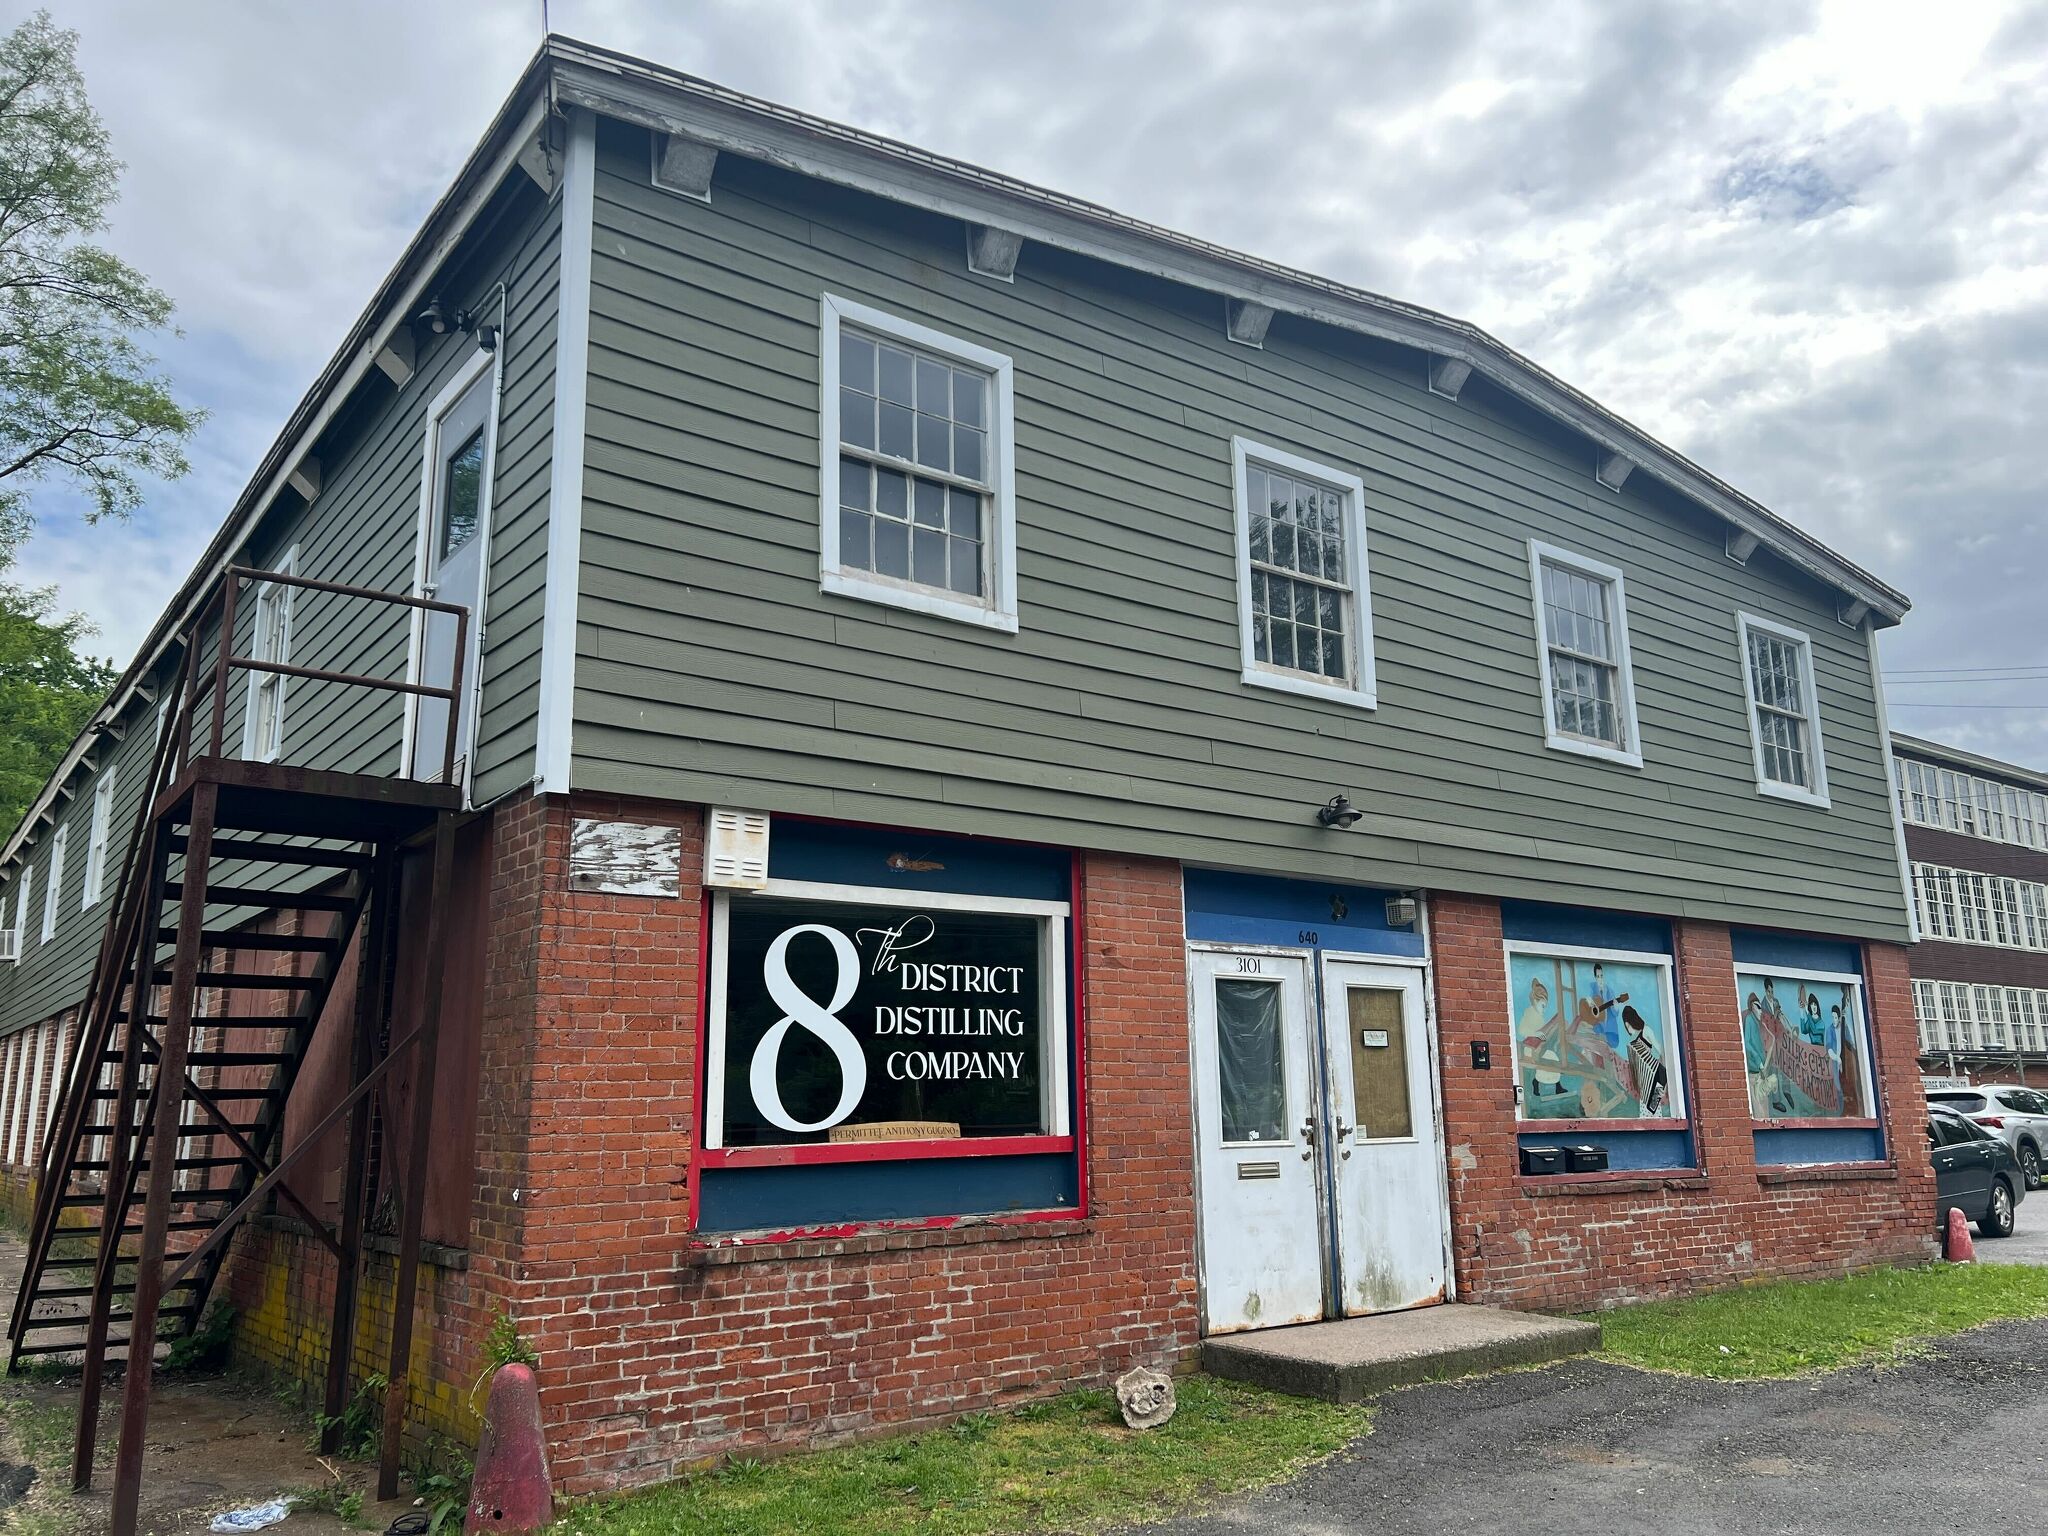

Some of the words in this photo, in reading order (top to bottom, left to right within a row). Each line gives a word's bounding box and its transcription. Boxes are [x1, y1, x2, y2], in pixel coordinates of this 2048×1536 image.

[1298, 930, 1319, 945] 640
[1235, 957, 1262, 974] 3101
[901, 963, 1024, 994] DISTRICT
[875, 1006, 1025, 1036] DISTILLING
[886, 1051, 1025, 1081] COMPANY
[885, 1126, 926, 1136] ANTHONY
